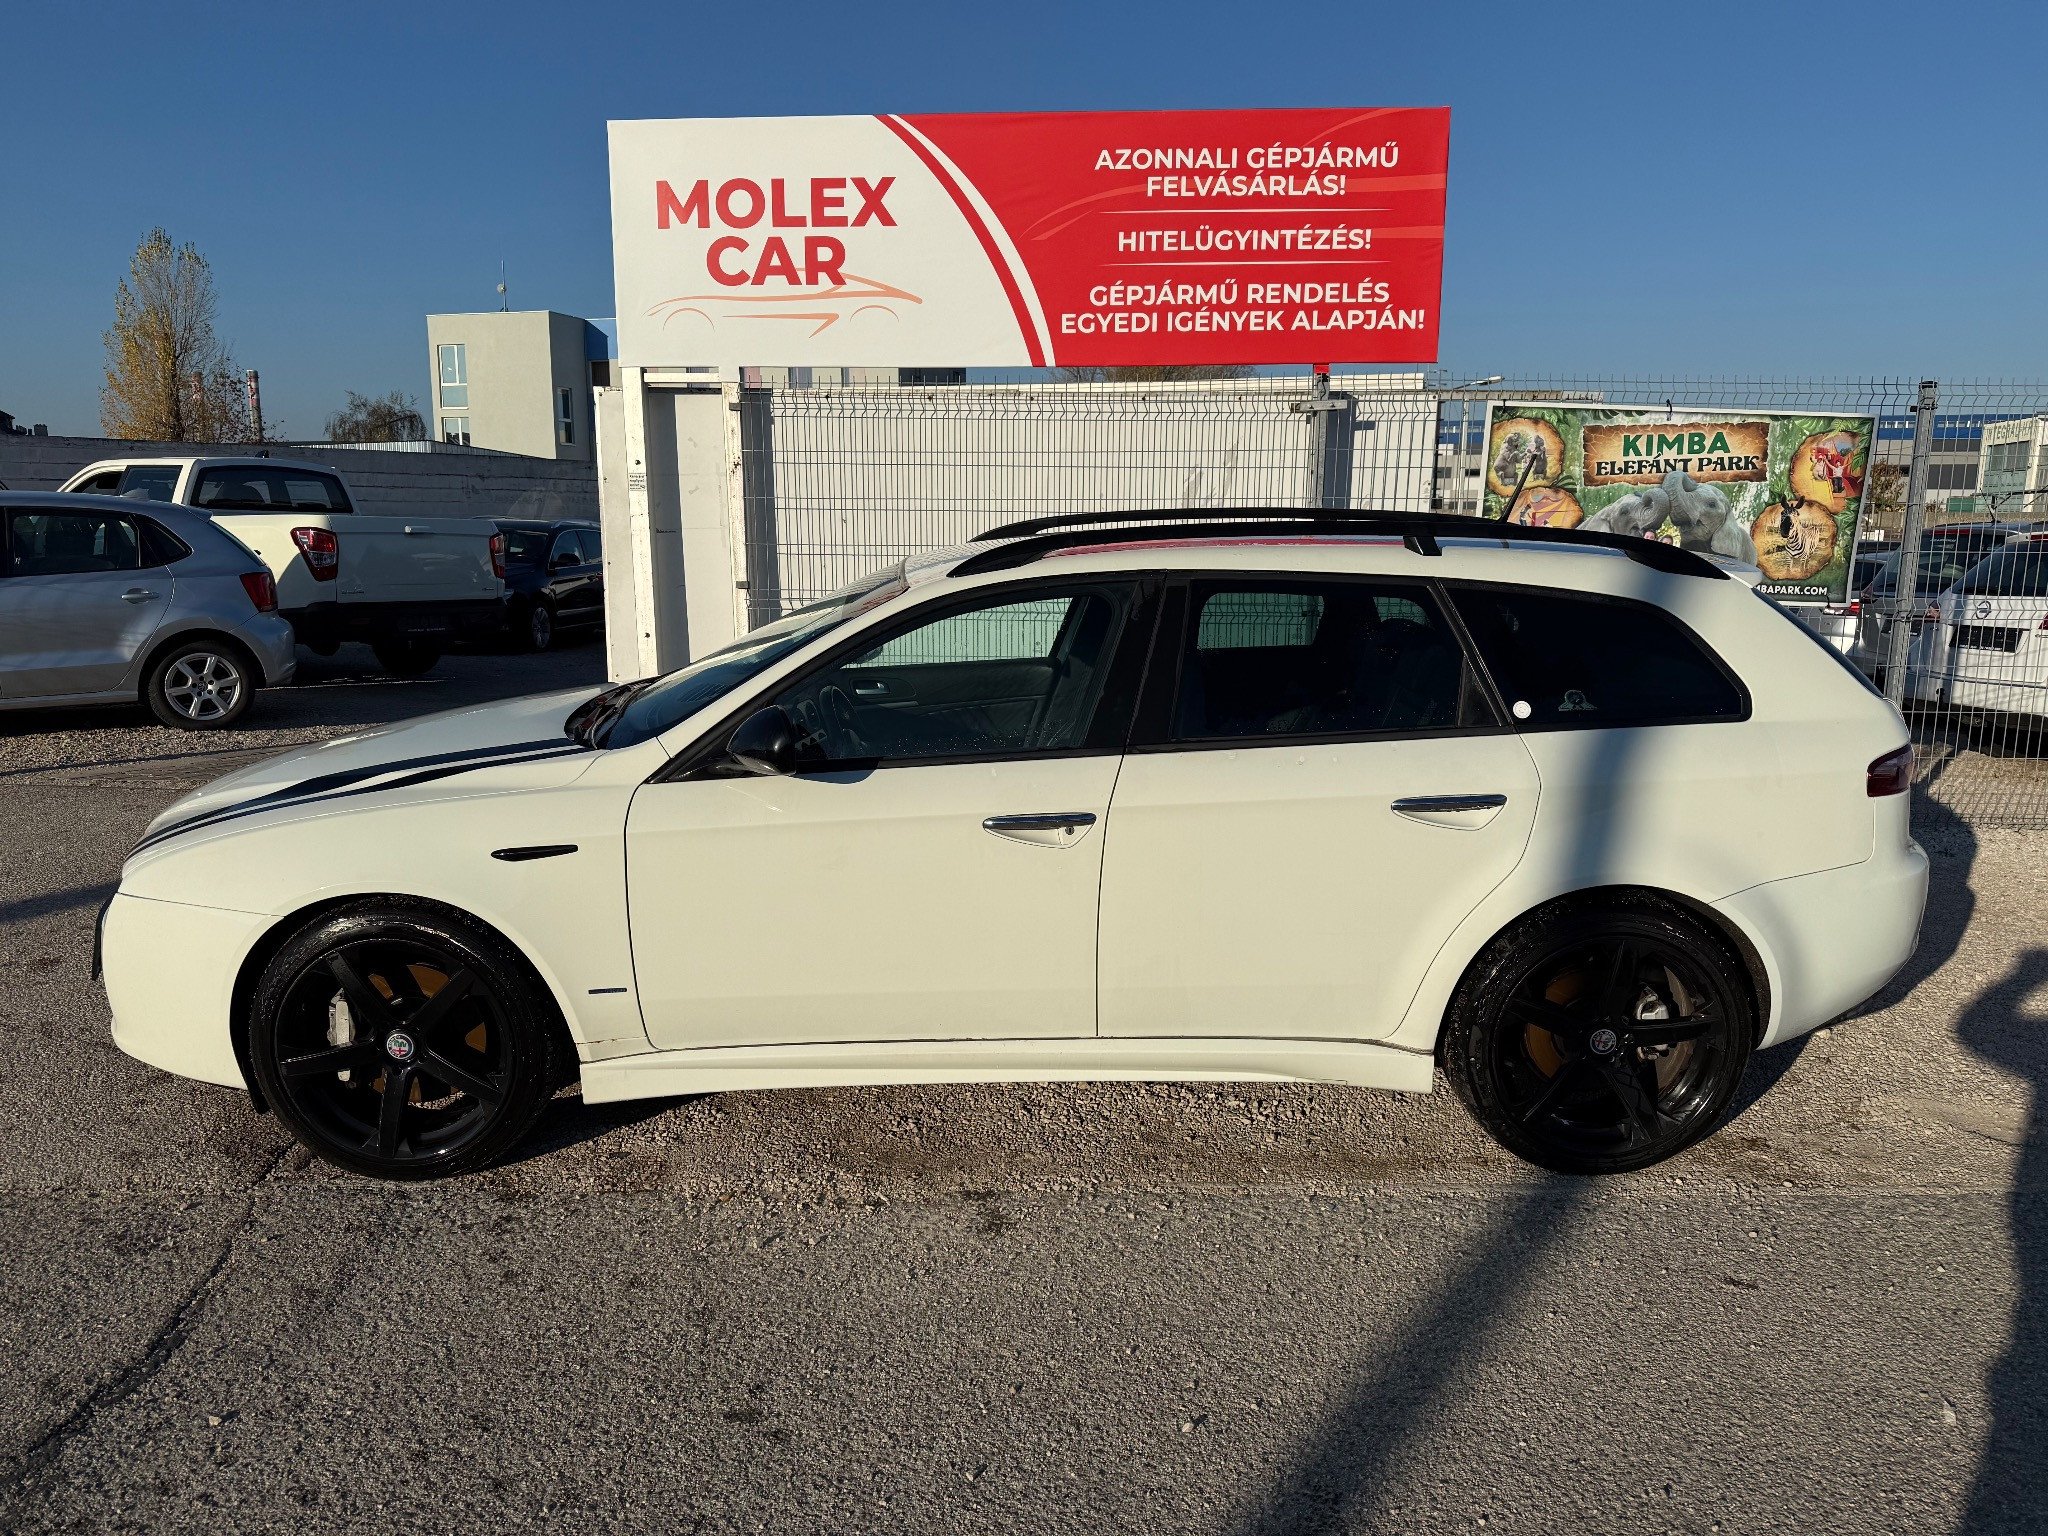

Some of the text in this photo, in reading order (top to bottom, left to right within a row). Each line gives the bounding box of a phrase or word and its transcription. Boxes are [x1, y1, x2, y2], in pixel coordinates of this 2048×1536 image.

[1094, 141, 1399, 171] AZONNALI GÉPJÁRMŰ
[1146, 169, 1346, 198] FELVÁSÁRLÁS!
[656, 176, 898, 229] MOLEX
[1118, 223, 1372, 252] HITELÜGYINTÉZÉS!
[706, 235, 848, 286] CAR
[1089, 277, 1389, 306] GÉPJÁRMŰ RENDELÉS
[1061, 304, 1425, 334] EGYEDI IGÉNYEK ALAPJÁN!
[1622, 431, 1731, 457] KIMBA
[1595, 451, 1760, 476] ELEFÁNT PARK
